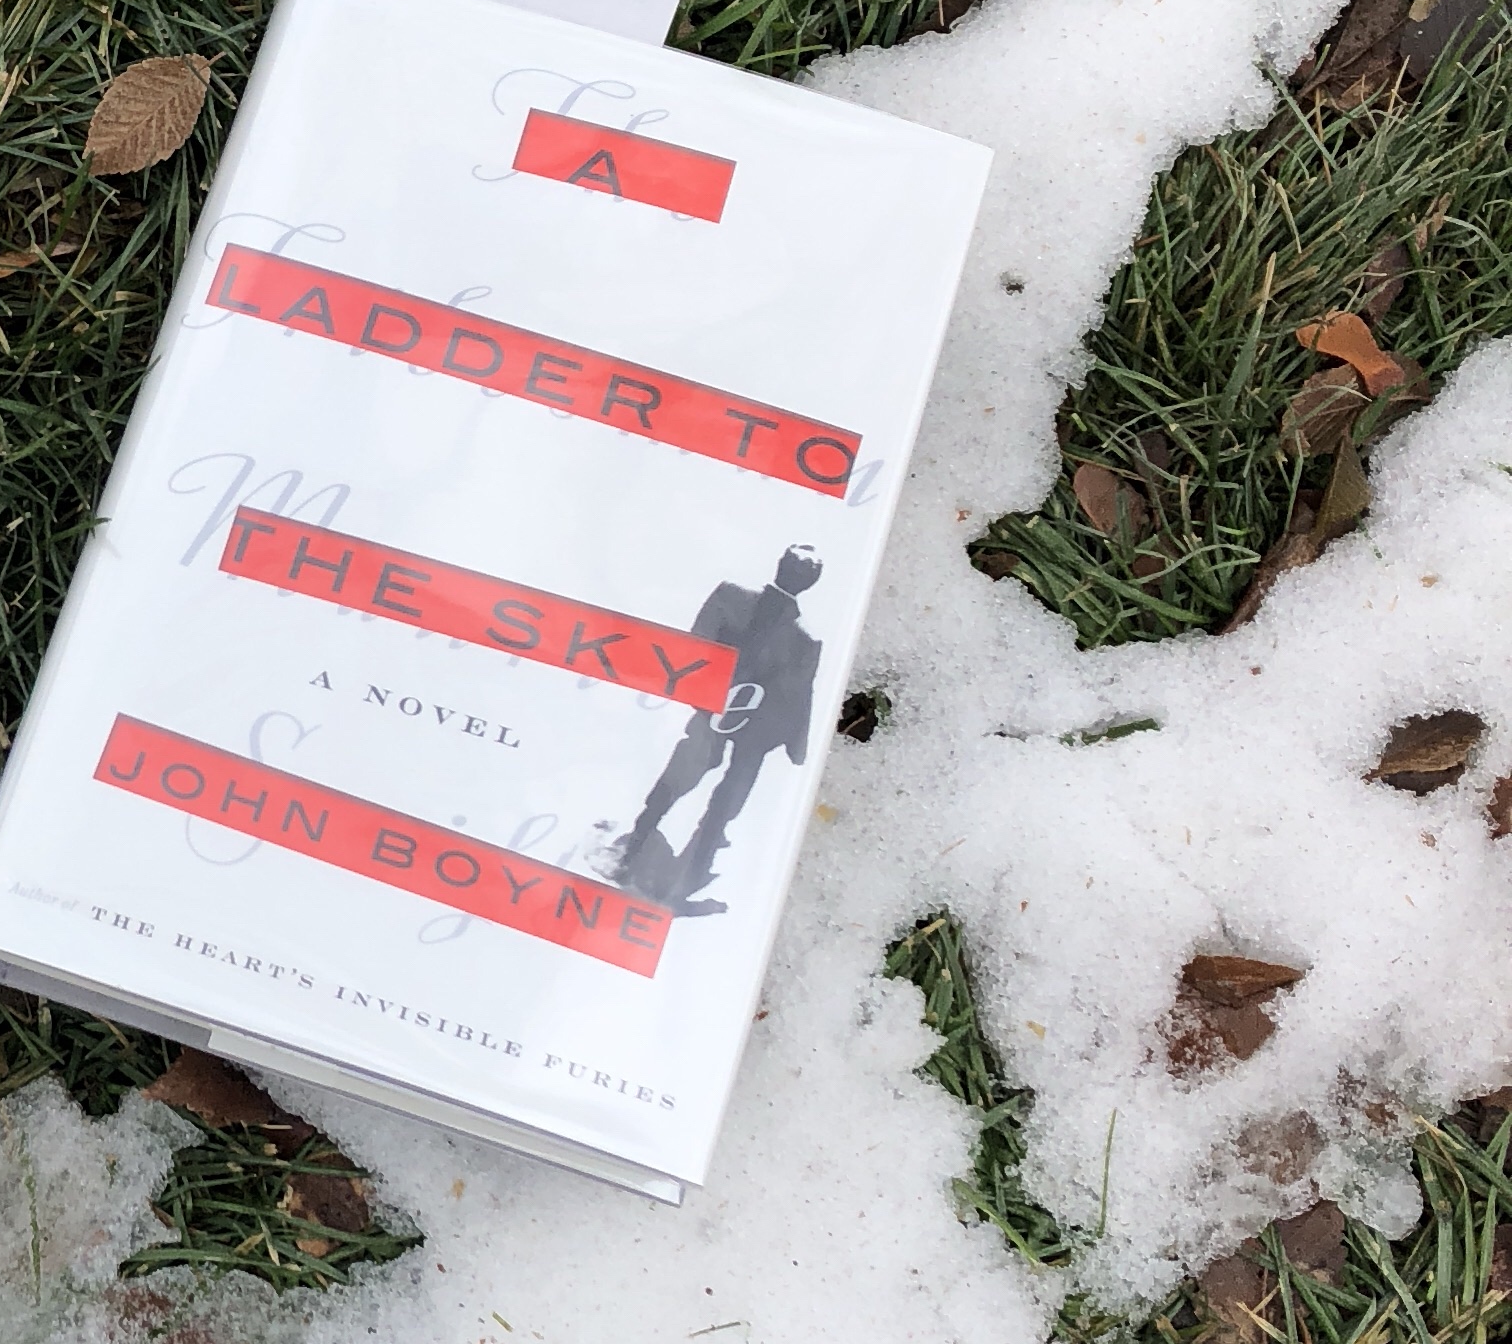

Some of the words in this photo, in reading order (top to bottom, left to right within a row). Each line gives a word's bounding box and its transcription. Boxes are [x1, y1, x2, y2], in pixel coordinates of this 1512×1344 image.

[566, 148, 622, 197] A
[218, 265, 662, 430] LADDER
[725, 409, 856, 484] TO
[233, 518, 431, 617] THE
[486, 599, 712, 695] SKY
[309, 670, 334, 691] A
[364, 683, 521, 748] NOVEL
[109, 752, 329, 842] JOHN
[371, 828, 662, 949] BOYNE
[8, 881, 59, 905] Author
[91, 905, 155, 938] THE
[174, 933, 315, 990] HEART'S
[335, 986, 523, 1057] INVISIBLE
[540, 1053, 677, 1110] FURIES
